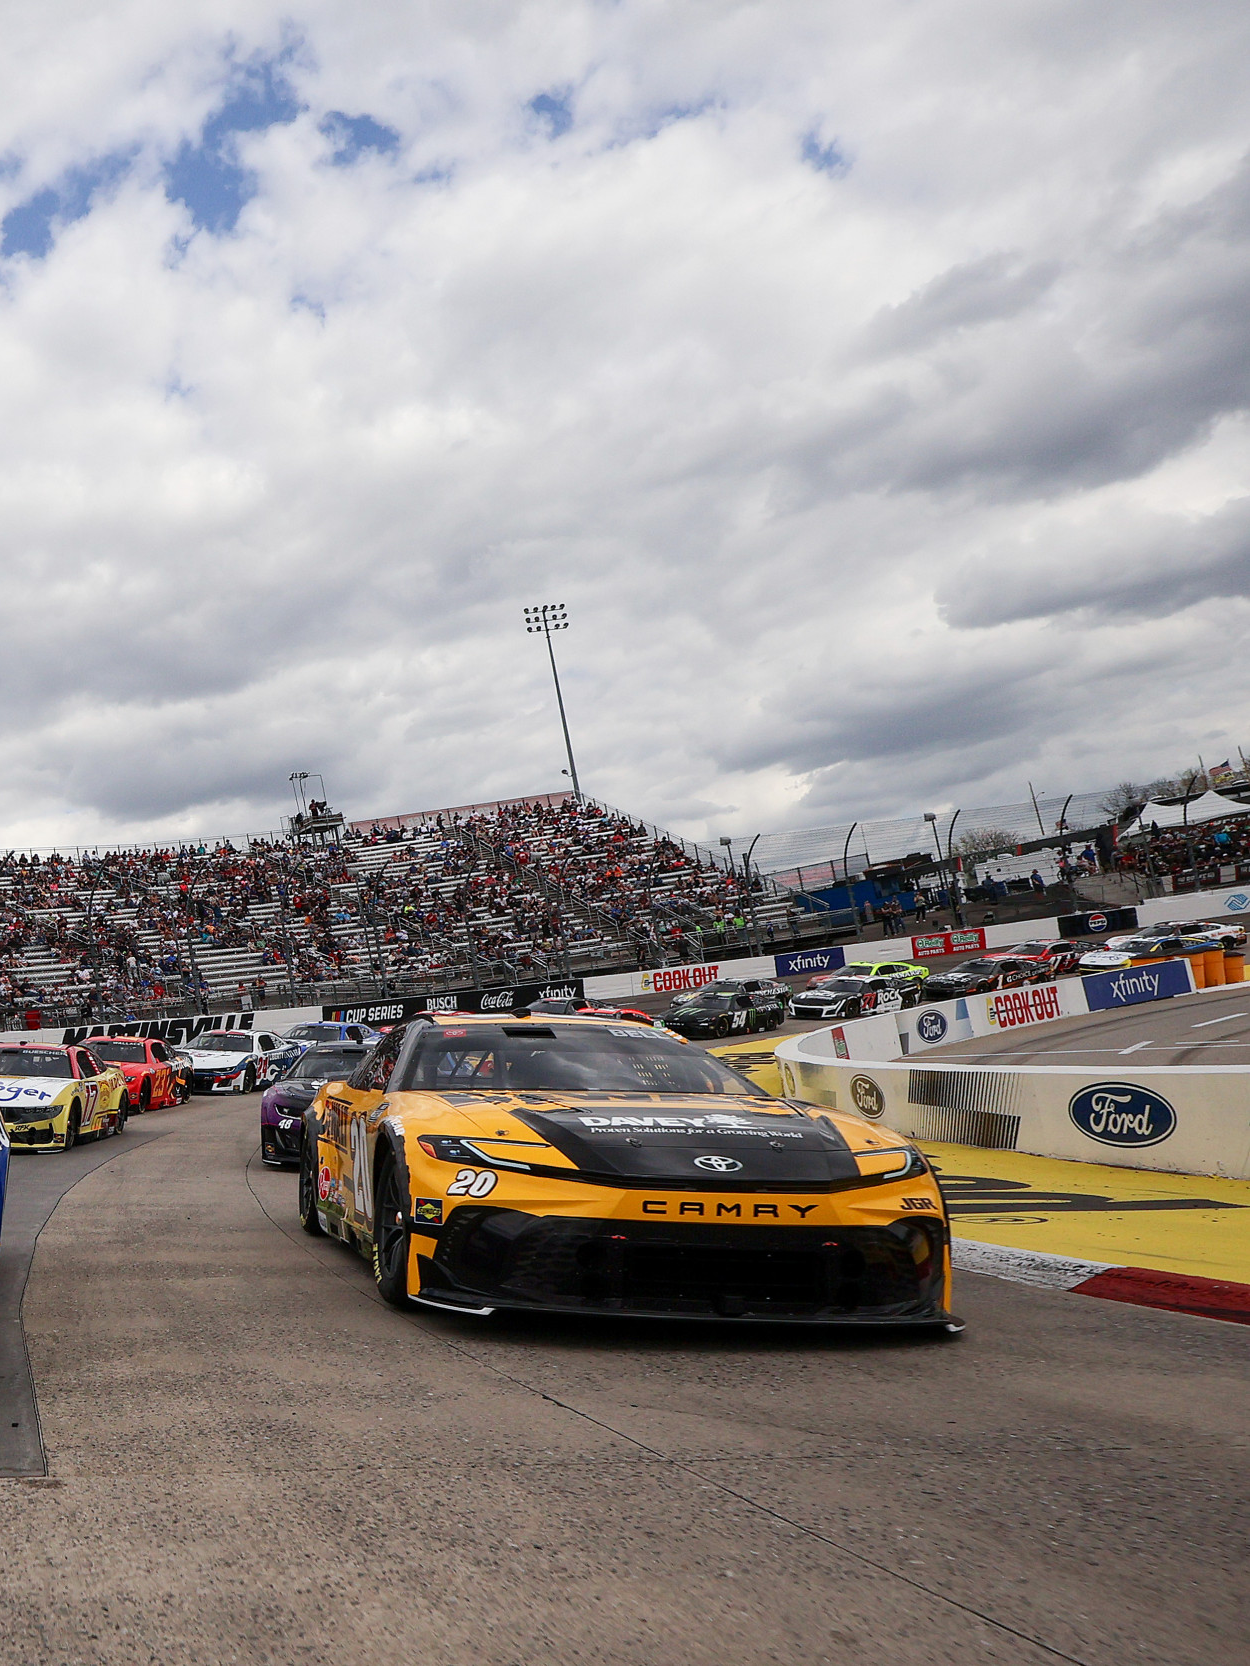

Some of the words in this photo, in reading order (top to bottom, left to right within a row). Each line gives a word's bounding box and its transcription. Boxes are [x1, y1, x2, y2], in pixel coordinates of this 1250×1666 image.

[788, 953, 830, 972] xfinity
[653, 968, 692, 992] COOK
[693, 965, 719, 988] OUT
[1109, 970, 1159, 1002] xfinity
[538, 985, 578, 998] xfinity
[426, 996, 458, 1011] BUSCH
[994, 990, 1036, 1029] COOK
[1037, 986, 1060, 1020] OUT
[346, 1008, 367, 1023] CUP
[368, 1004, 404, 1021] SERIES
[731, 1010, 748, 1028] 54
[608, 1029, 671, 1040] BELL
[923, 1015, 943, 1038] Ford
[856, 1081, 879, 1111] Ford
[578, 1115, 705, 1128] DAVEY
[1090, 1092, 1153, 1135] Ford
[278, 1119, 294, 1130] 48
[590, 1126, 632, 1134] Proven
[632, 1126, 686, 1135] Solutions
[685, 1127, 704, 1136] for
[716, 1128, 768, 1138] Growing
[768, 1130, 804, 1139] World
[447, 1169, 499, 1198] 20
[642, 1200, 819, 1218] CAMRY
[899, 1197, 938, 1211] JGR
